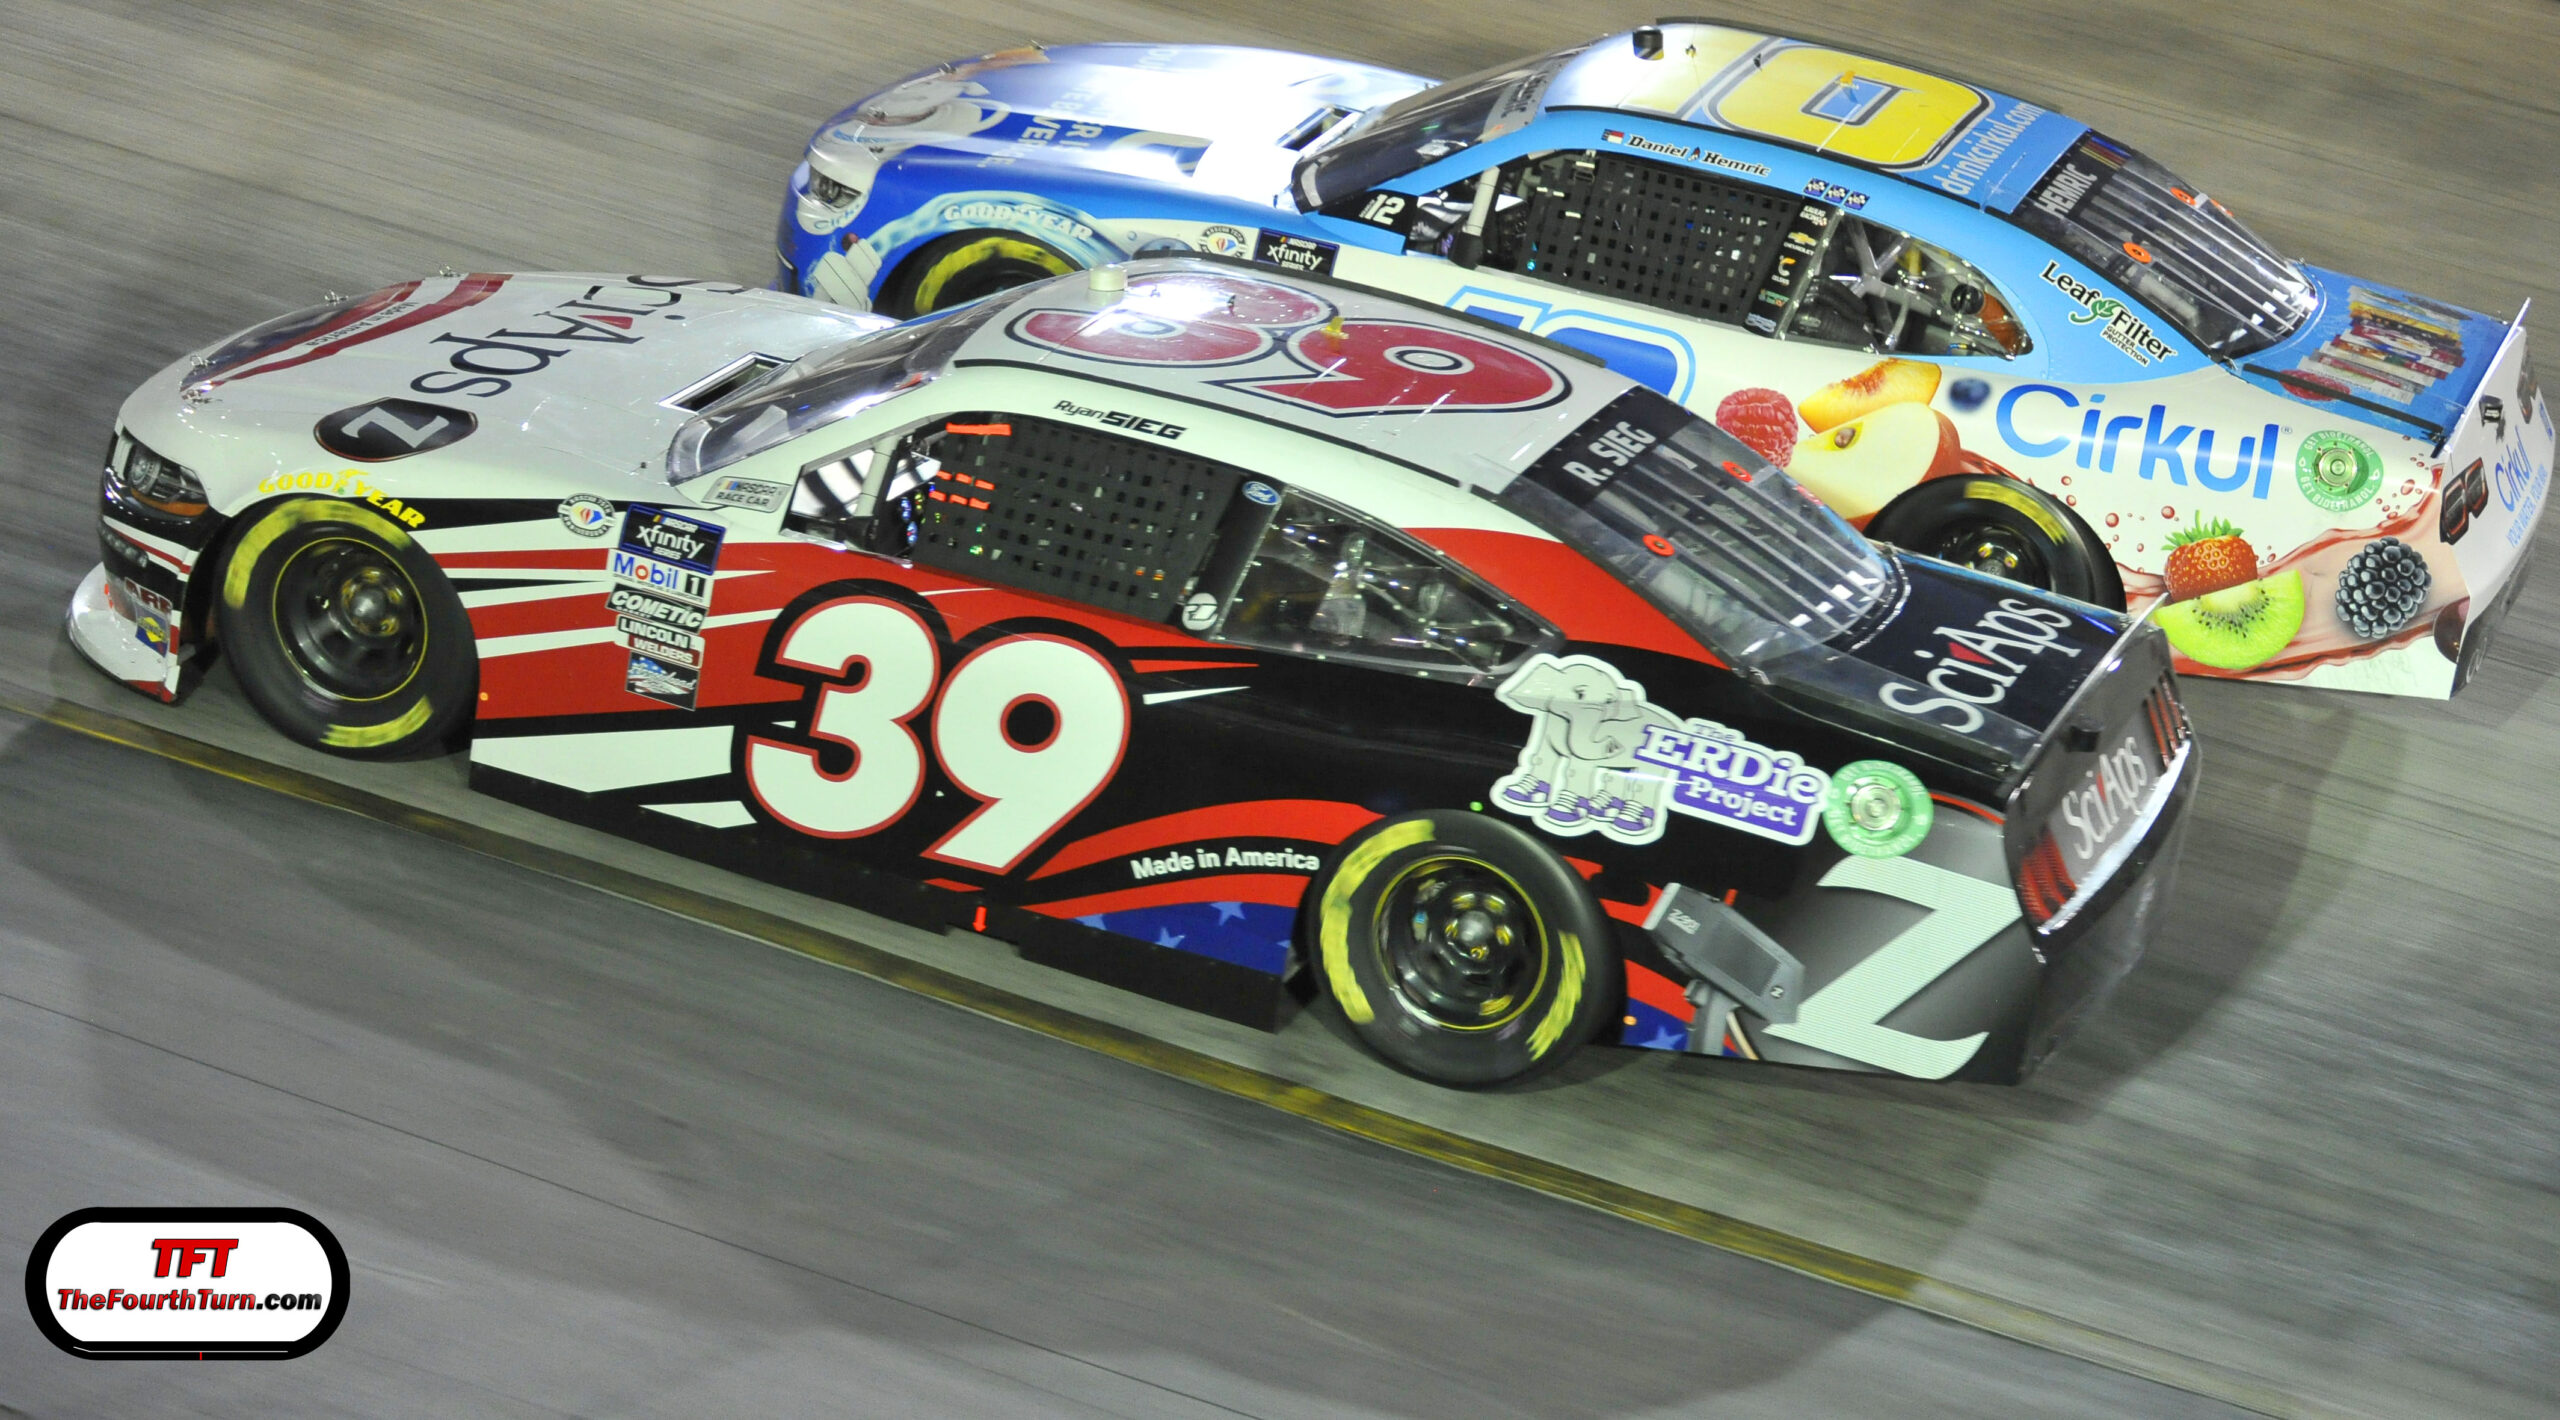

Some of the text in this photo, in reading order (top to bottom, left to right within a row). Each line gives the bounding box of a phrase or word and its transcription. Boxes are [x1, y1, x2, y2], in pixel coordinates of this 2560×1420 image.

[1628, 134, 1771, 177] Daniel Hemric
[1933, 102, 2048, 196] drinkcirkul.com
[1364, 193, 1406, 225] 12
[2034, 163, 2098, 219] HEMRIC
[944, 201, 1094, 241] GOODYEAR
[1267, 243, 1323, 271] xfinity
[2041, 261, 2101, 307] Leaf
[410, 274, 750, 398] SciAps
[2102, 330, 2149, 366] PROTECTION
[2106, 325, 2136, 349] GUTTER
[2111, 309, 2174, 361] Filter
[1053, 399, 1188, 440] Ryan SIEG
[1562, 421, 1657, 487] R. SIEG
[1996, 383, 2280, 500] Cirkul
[258, 468, 426, 529] GOODYEAR
[716, 491, 771, 507] RACE CAR
[636, 524, 705, 559] xfinity
[614, 552, 680, 590] Mobil
[690, 576, 701, 595] 1
[611, 590, 704, 628] COMETIC
[620, 617, 691, 649] LINCOLN
[634, 637, 694, 665] WELDERS
[1879, 598, 2082, 734] SciAps
[745, 596, 1131, 875] 39
[1693, 723, 1737, 741] The
[1635, 725, 1824, 805] ERDie
[1685, 775, 1798, 827] Project
[2062, 736, 2148, 860] SciAps
[1130, 846, 1321, 880] Made in America
